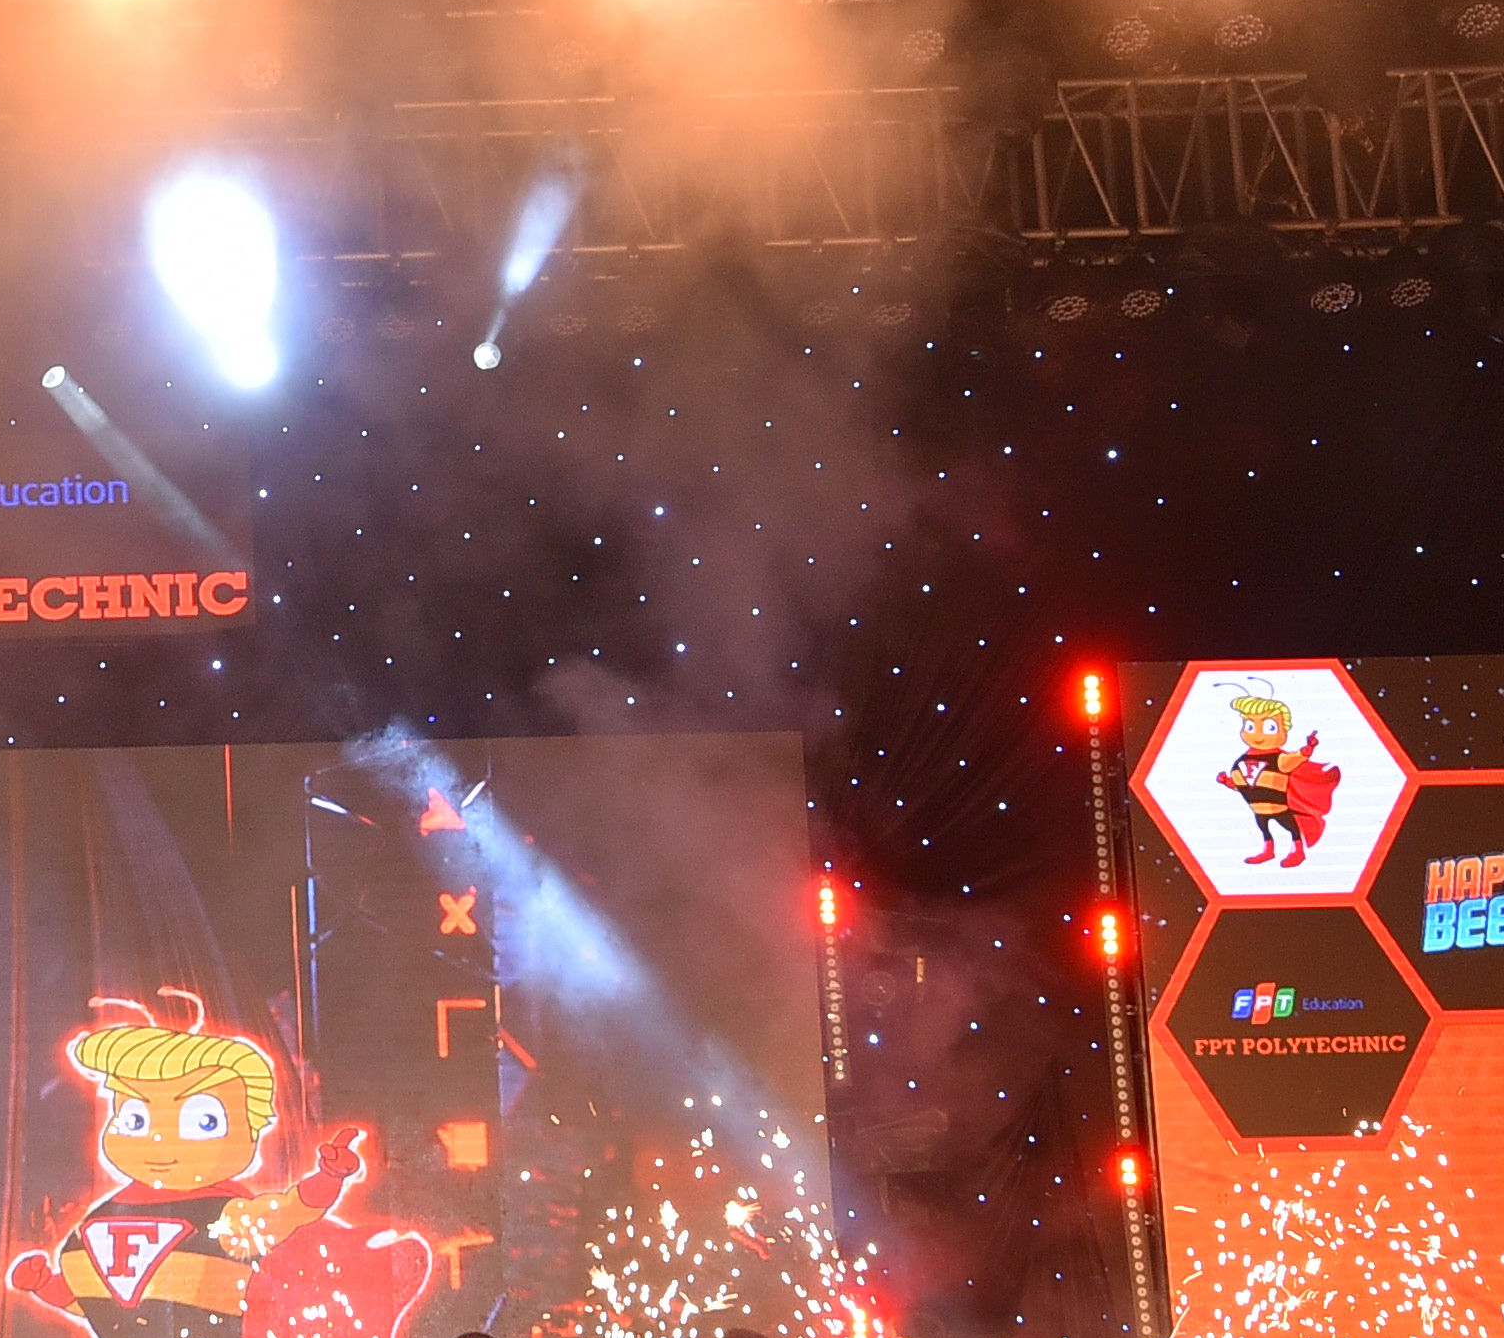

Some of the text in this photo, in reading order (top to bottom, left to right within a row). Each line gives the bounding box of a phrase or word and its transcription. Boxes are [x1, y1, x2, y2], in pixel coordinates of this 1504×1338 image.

[1301, 996, 1365, 1012] Education
[1194, 1034, 1407, 1056] FPT POLYTECHNIC
[107, 1224, 160, 1278] F
